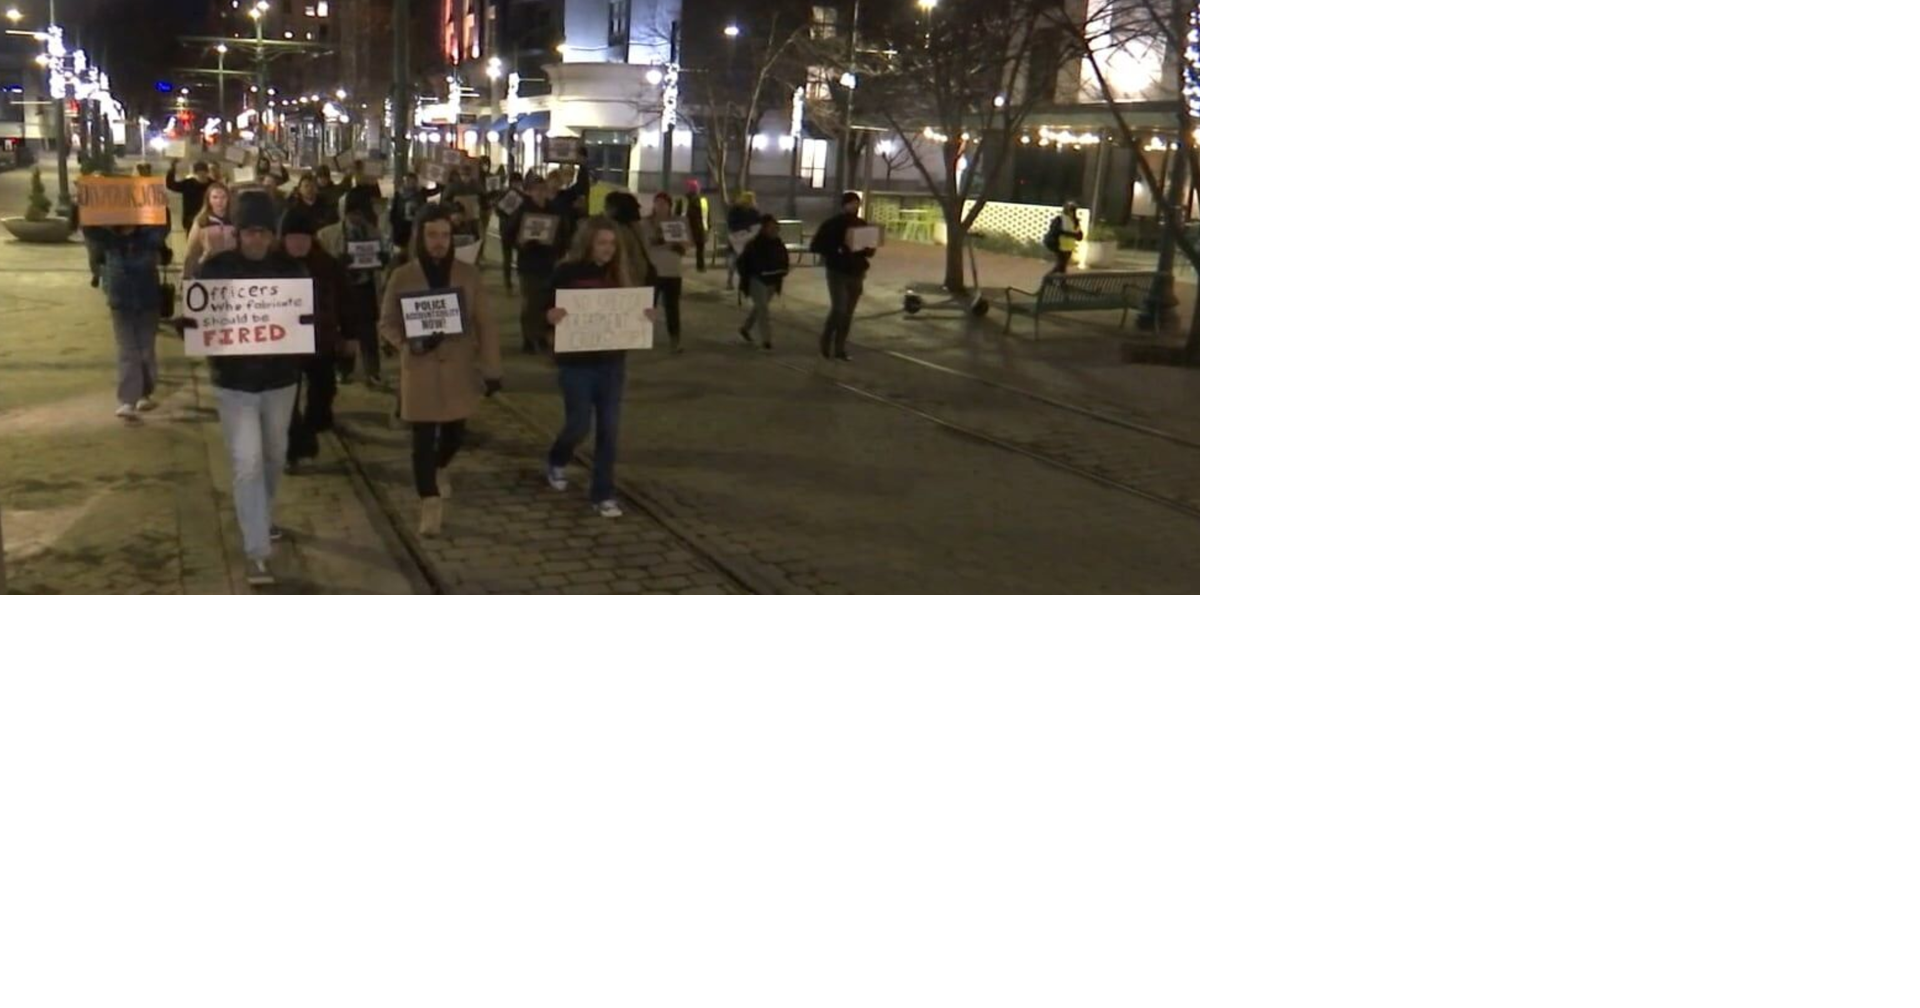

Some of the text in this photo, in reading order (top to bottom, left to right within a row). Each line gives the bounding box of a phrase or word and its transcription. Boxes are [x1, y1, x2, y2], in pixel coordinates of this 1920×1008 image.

[186, 282, 279, 312] Officers
[414, 298, 447, 311] POLICE
[203, 313, 270, 328] should be
[203, 324, 286, 347] FIRED
